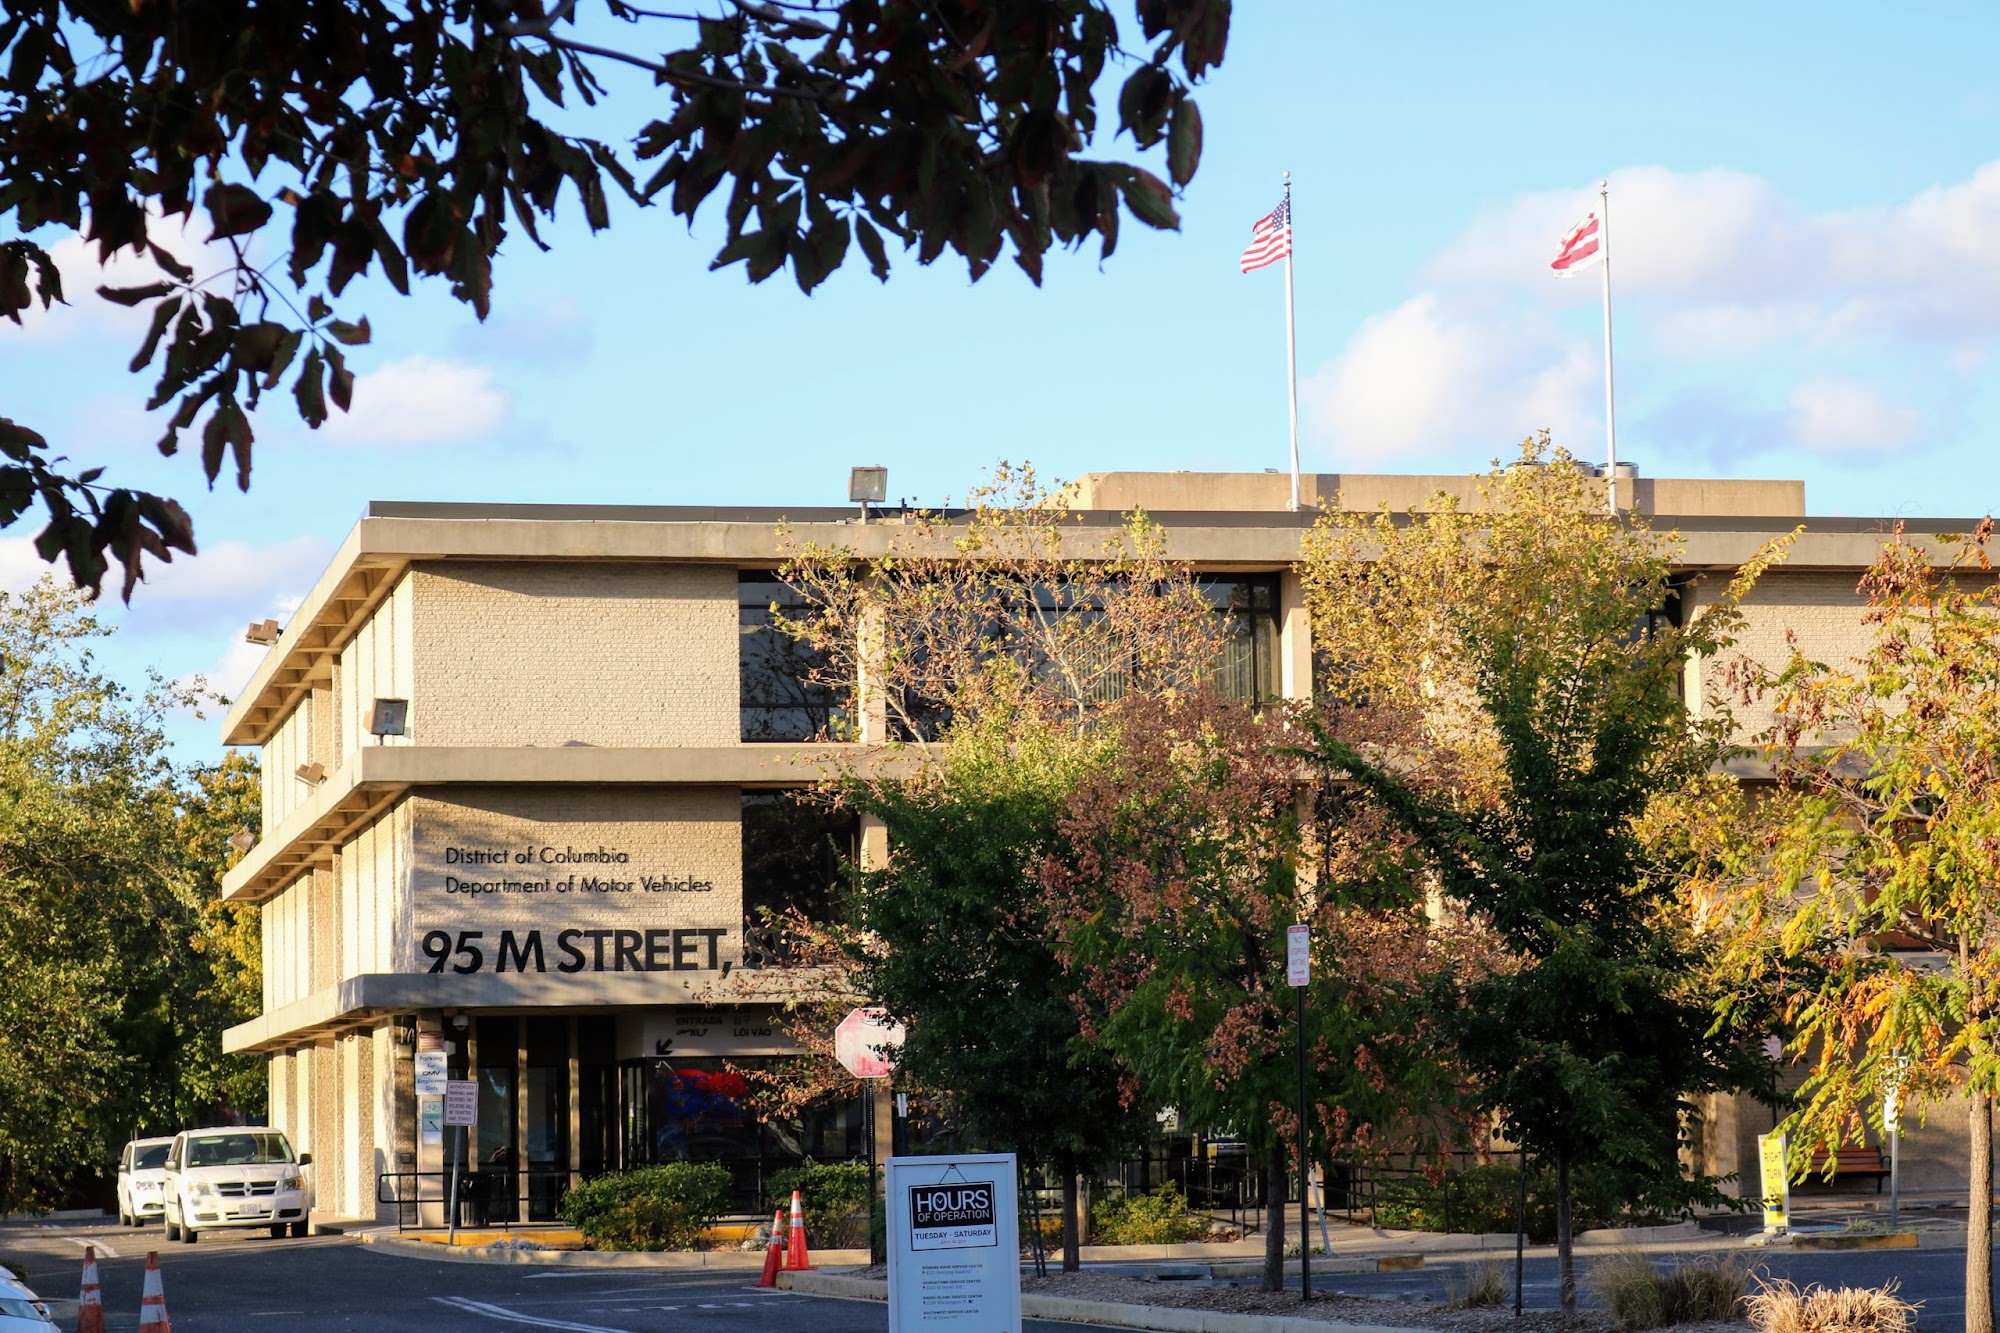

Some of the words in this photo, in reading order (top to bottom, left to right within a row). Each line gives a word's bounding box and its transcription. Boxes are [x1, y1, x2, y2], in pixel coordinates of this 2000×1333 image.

[446, 847, 508, 864] District
[515, 846, 533, 864] of
[540, 846, 629, 864] Columbia
[446, 876, 550, 898] Department
[556, 875, 574, 893] of
[581, 876, 633, 893] Motor
[641, 875, 712, 893] Vehicles
[422, 930, 483, 974] 95
[495, 930, 546, 973] M
[557, 928, 732, 981] STREET,
[676, 1017, 722, 1025] ENTRADA
[1764, 1151, 1782, 1163] RIGHT
[1766, 1169, 1782, 1180] TURN
[1768, 1186, 1782, 1196] ONLY
[916, 1189, 989, 1212] HOURS
[917, 1212, 931, 1223] OF
[933, 1209, 990, 1222] OPERATION
[915, 1232, 948, 1240] TUESDAY
[954, 1229, 992, 1238] SATURDAY
